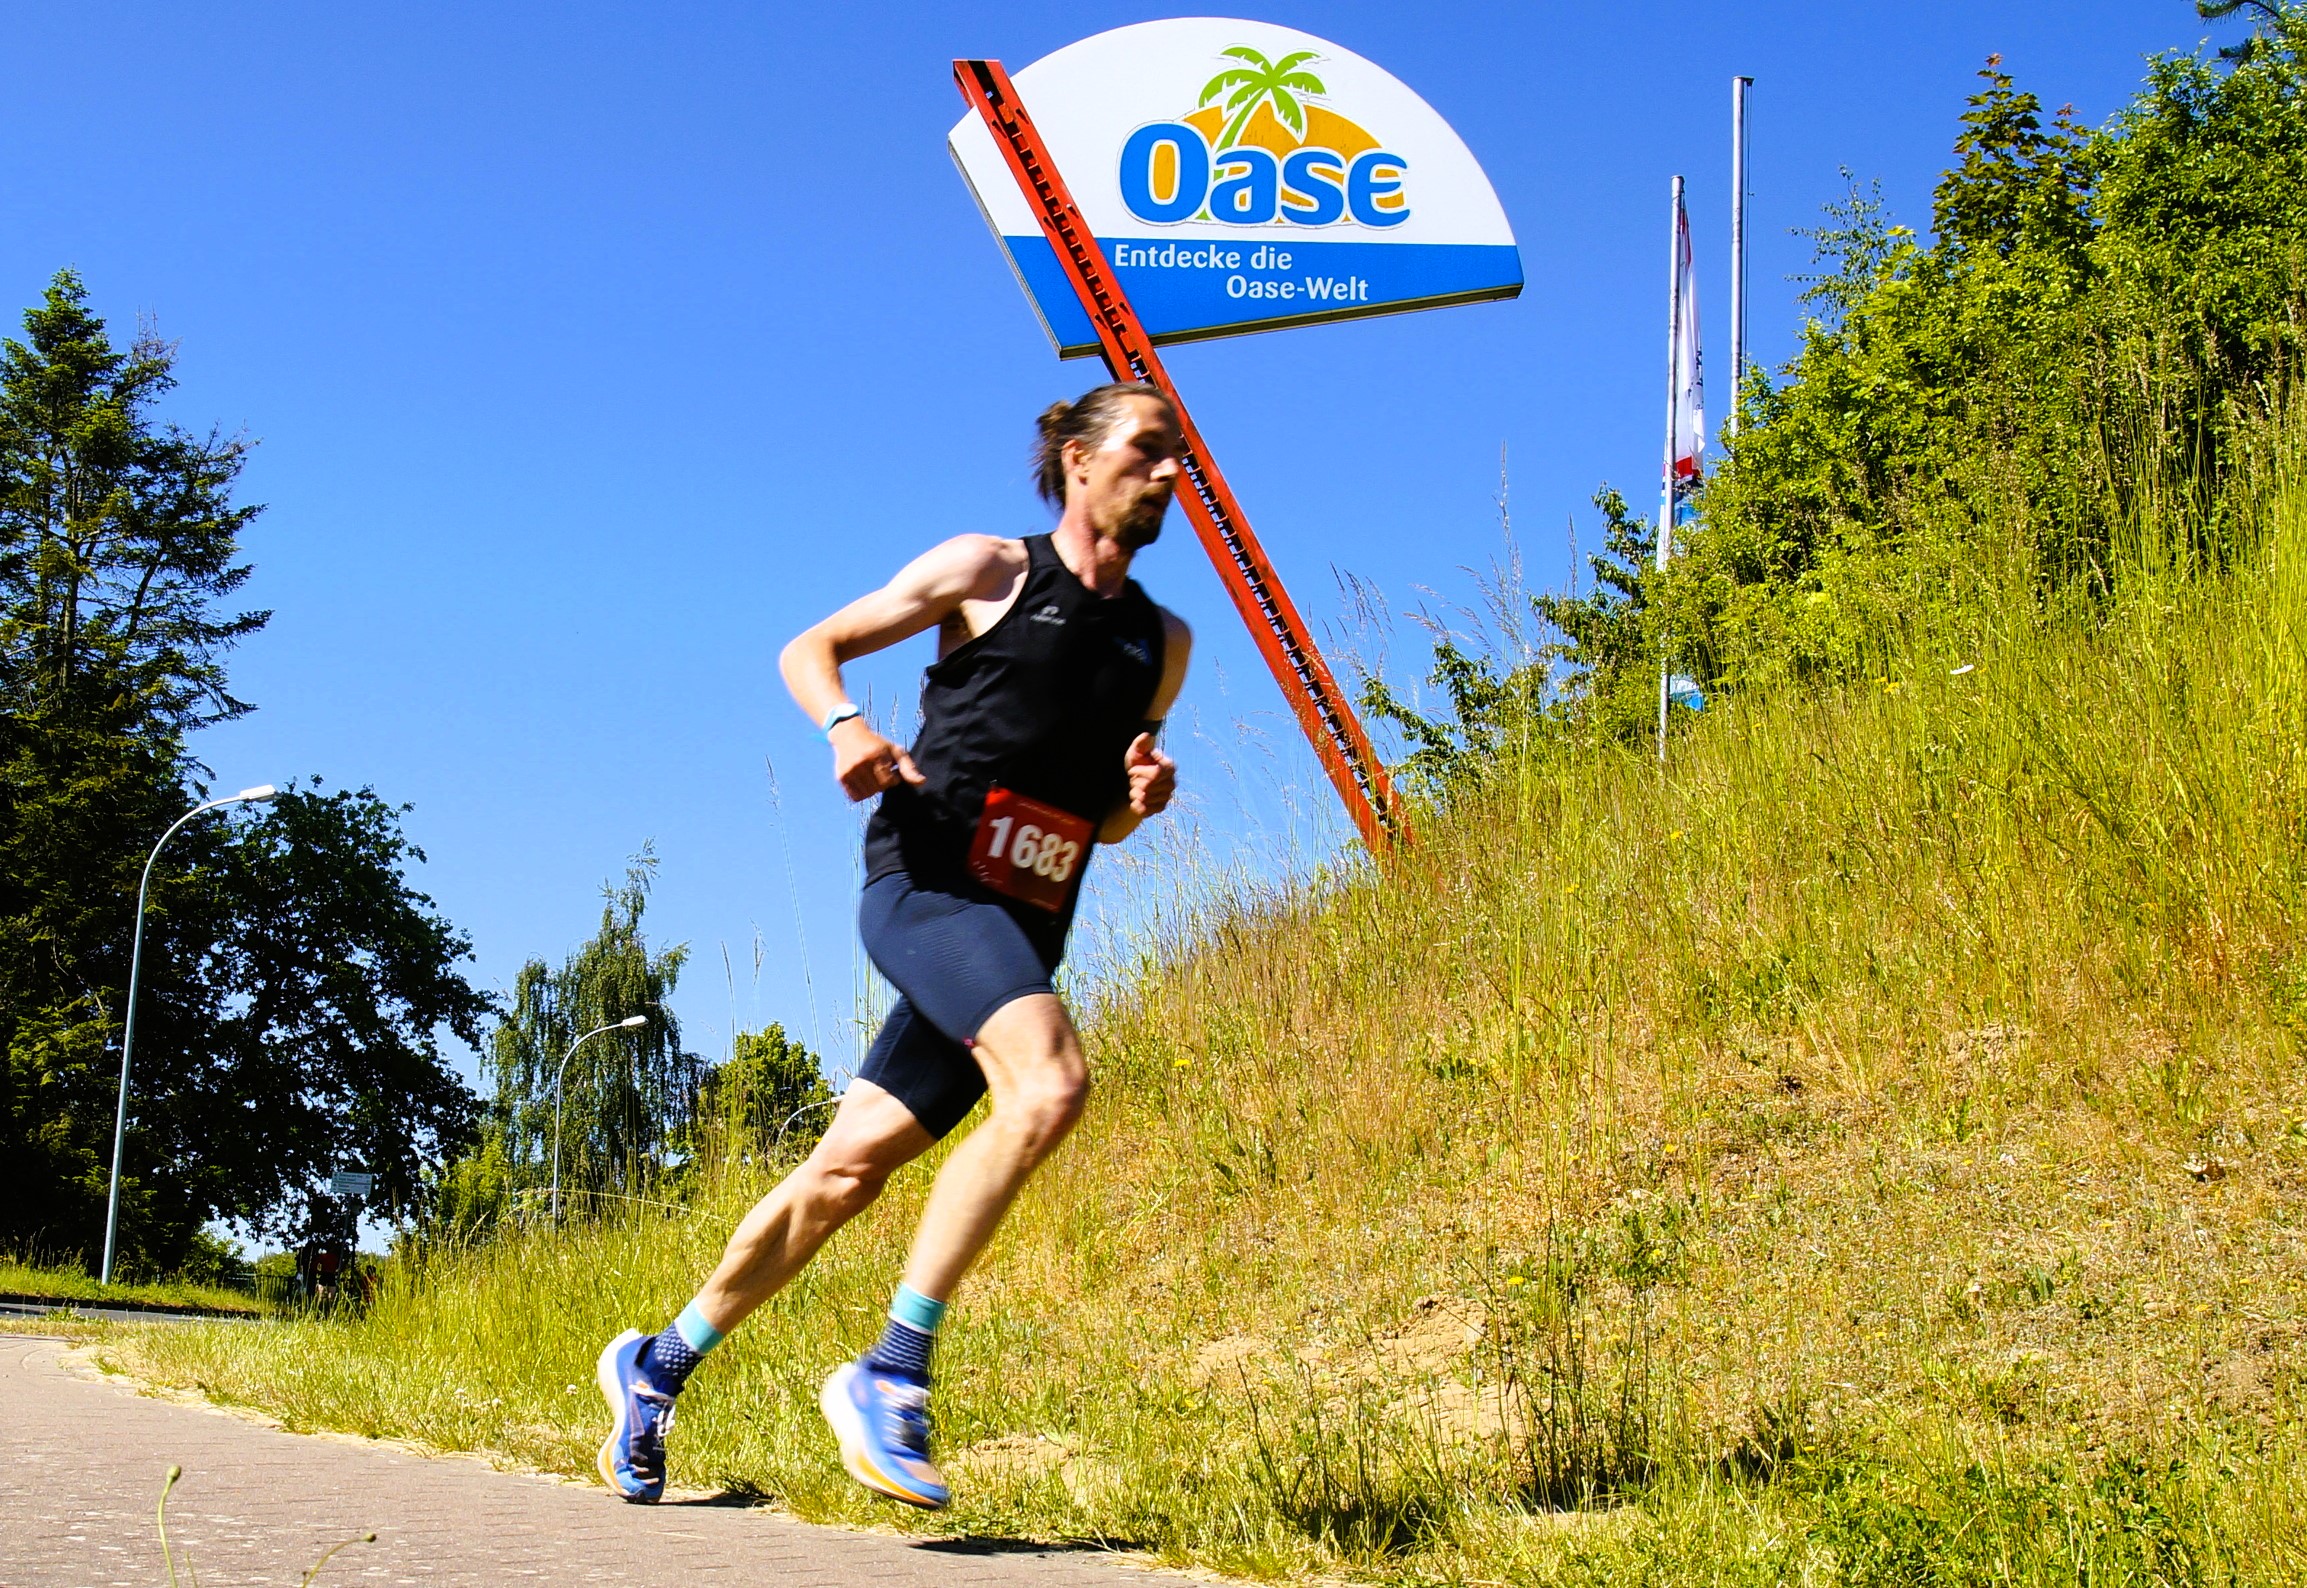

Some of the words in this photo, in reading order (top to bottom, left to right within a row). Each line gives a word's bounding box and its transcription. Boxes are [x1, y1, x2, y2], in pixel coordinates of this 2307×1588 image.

[1118, 121, 1411, 228] Oase
[1114, 243, 1241, 269] Entdecke
[1250, 245, 1292, 270] die
[1226, 275, 1369, 301] Oase-Welt
[987, 815, 1080, 882] 1683
